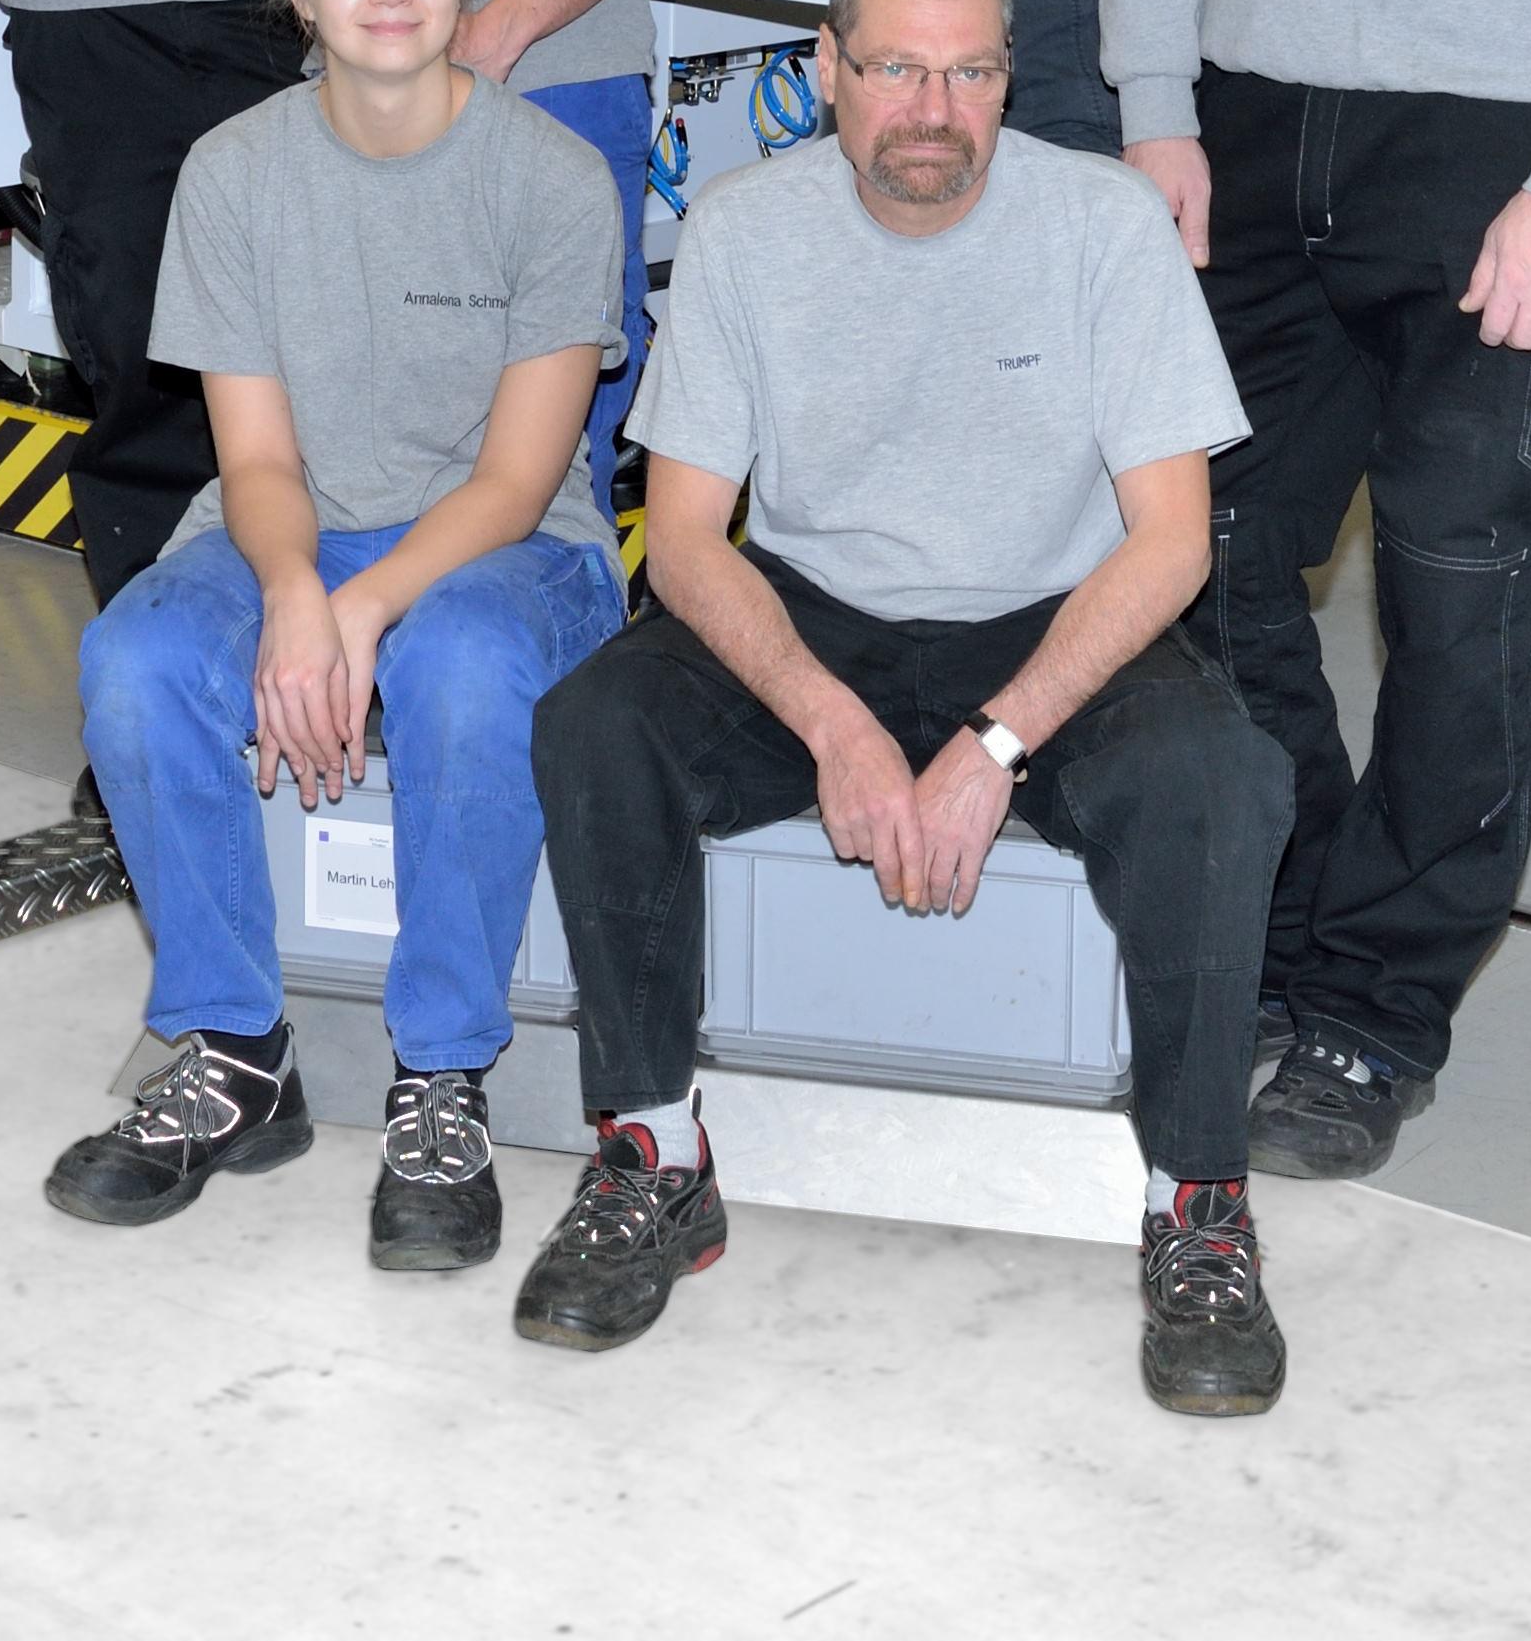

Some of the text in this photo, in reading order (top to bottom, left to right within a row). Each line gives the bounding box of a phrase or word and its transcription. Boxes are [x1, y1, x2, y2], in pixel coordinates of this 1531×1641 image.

[403, 291, 462, 308] Annalena
[996, 353, 1042, 372] TRUMPF
[327, 870, 367, 887] Martin
